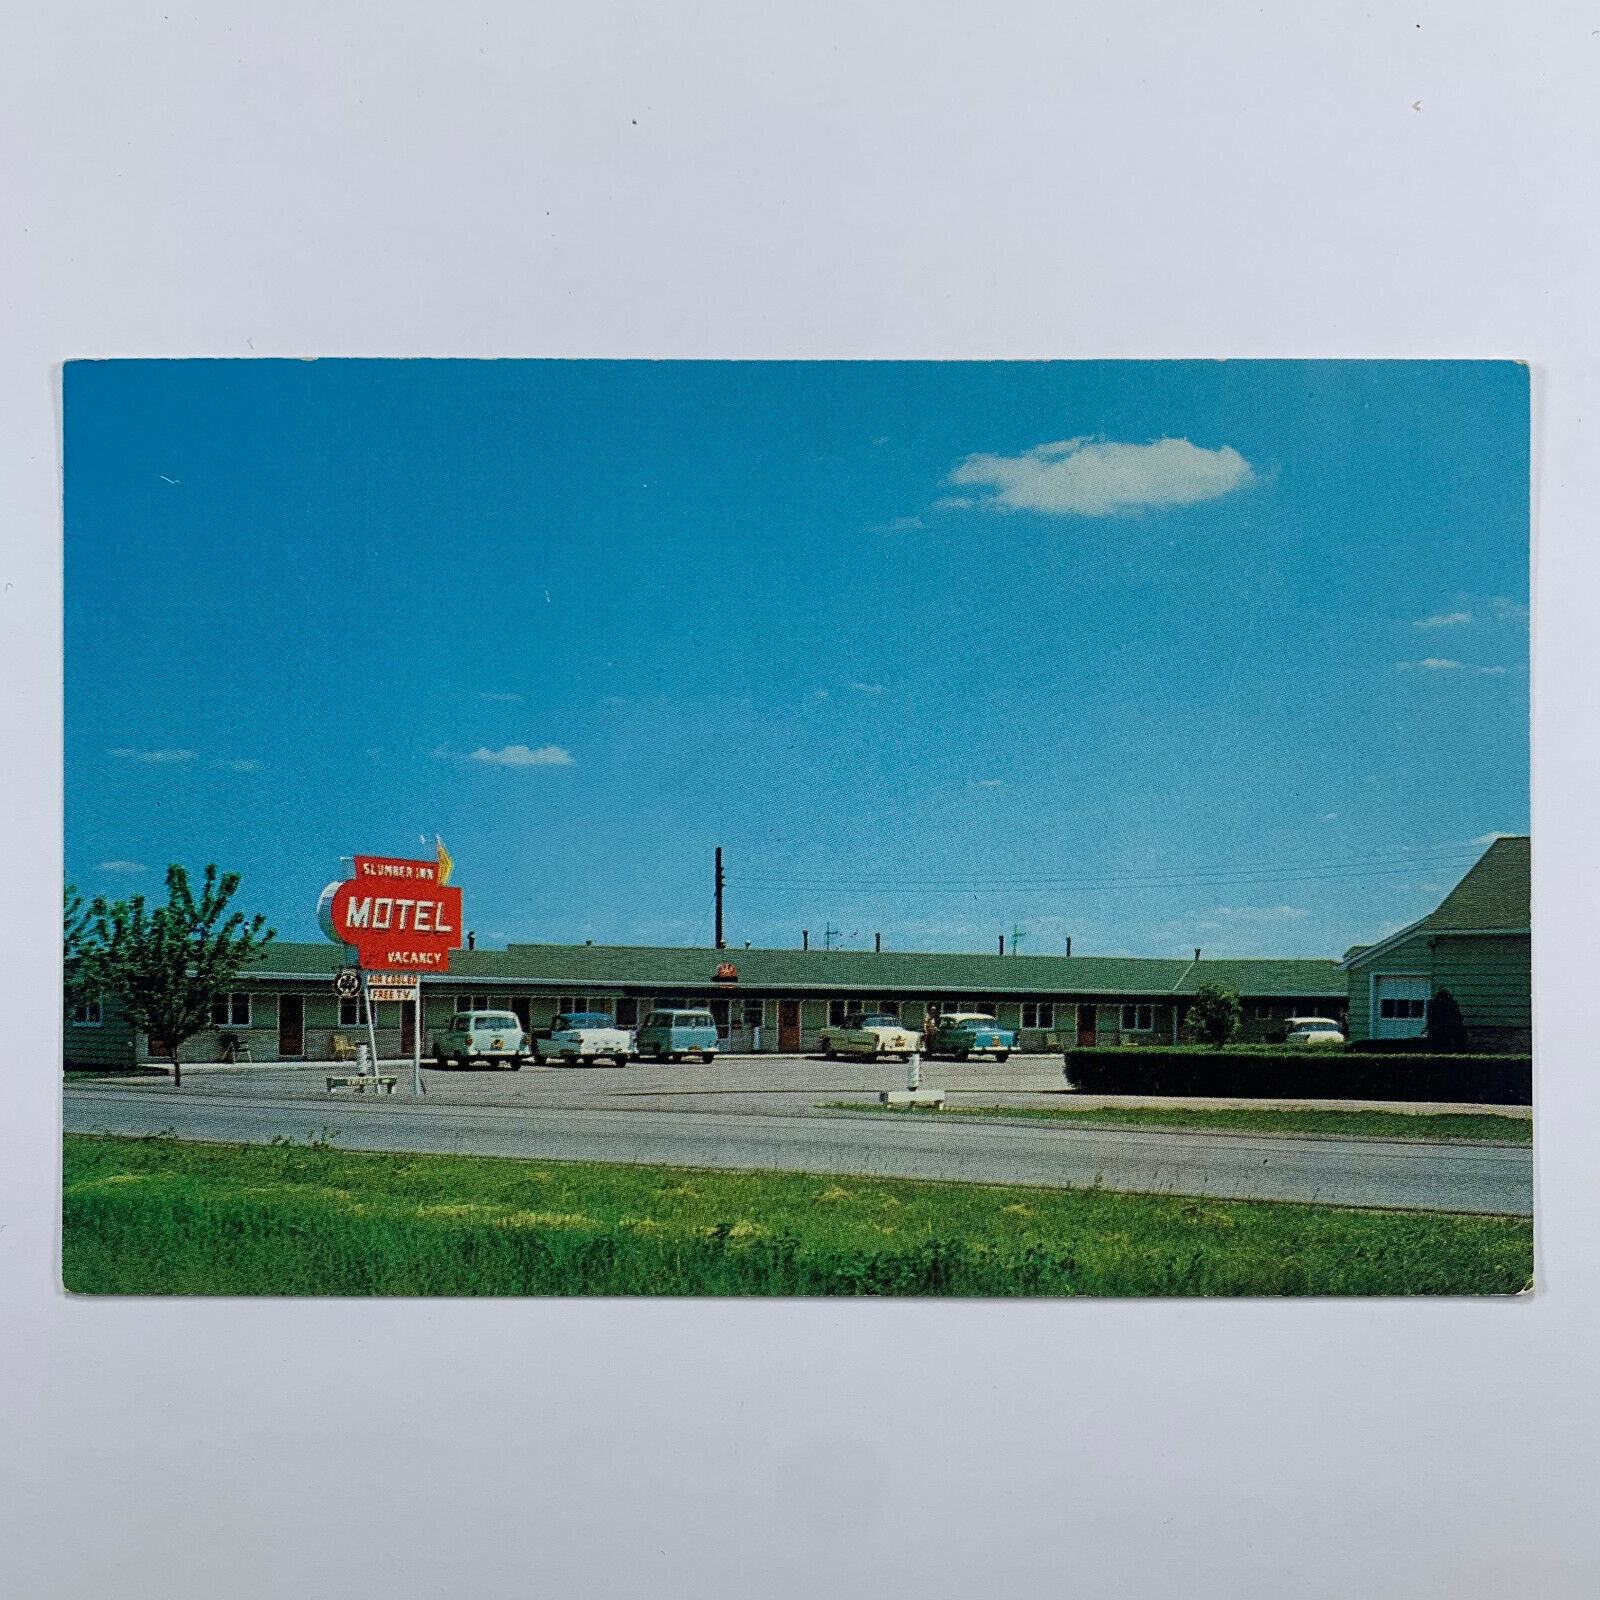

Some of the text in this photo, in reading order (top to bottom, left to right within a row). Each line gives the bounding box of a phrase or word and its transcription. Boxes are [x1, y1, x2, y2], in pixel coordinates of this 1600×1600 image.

[363, 863, 413, 877] SLUMBER
[346, 896, 452, 932] MOTEL
[387, 952, 441, 964] VACANCY
[373, 990, 395, 999] FREE
